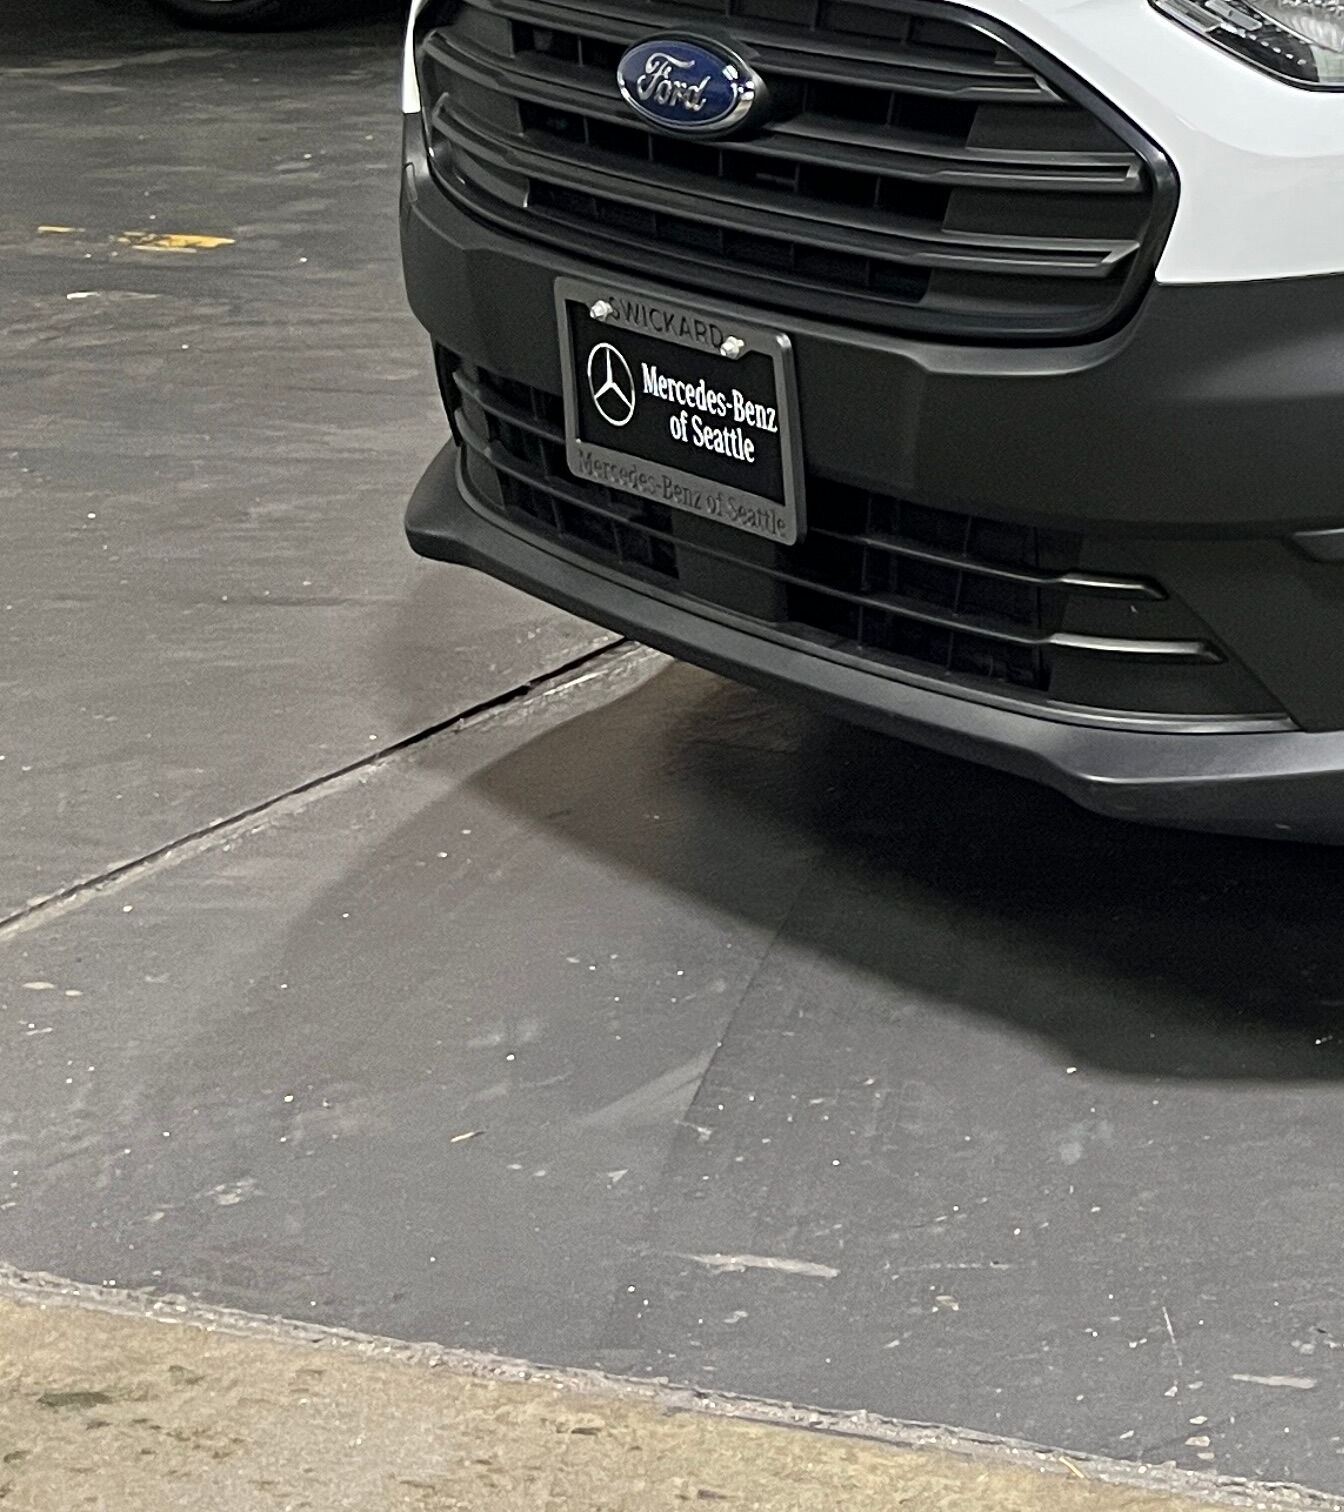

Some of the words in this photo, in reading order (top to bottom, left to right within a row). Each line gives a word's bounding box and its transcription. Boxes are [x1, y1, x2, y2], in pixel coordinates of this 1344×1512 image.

[637, 52, 712, 112] Ford
[606, 296, 724, 349] SWICKARD
[640, 362, 779, 434] Mercedes-Benz
[669, 409, 689, 443] of
[693, 413, 755, 464] Seattle
[577, 448, 702, 510] Mercedes-Benz
[706, 491, 724, 517] of
[728, 497, 787, 538] Seattle
